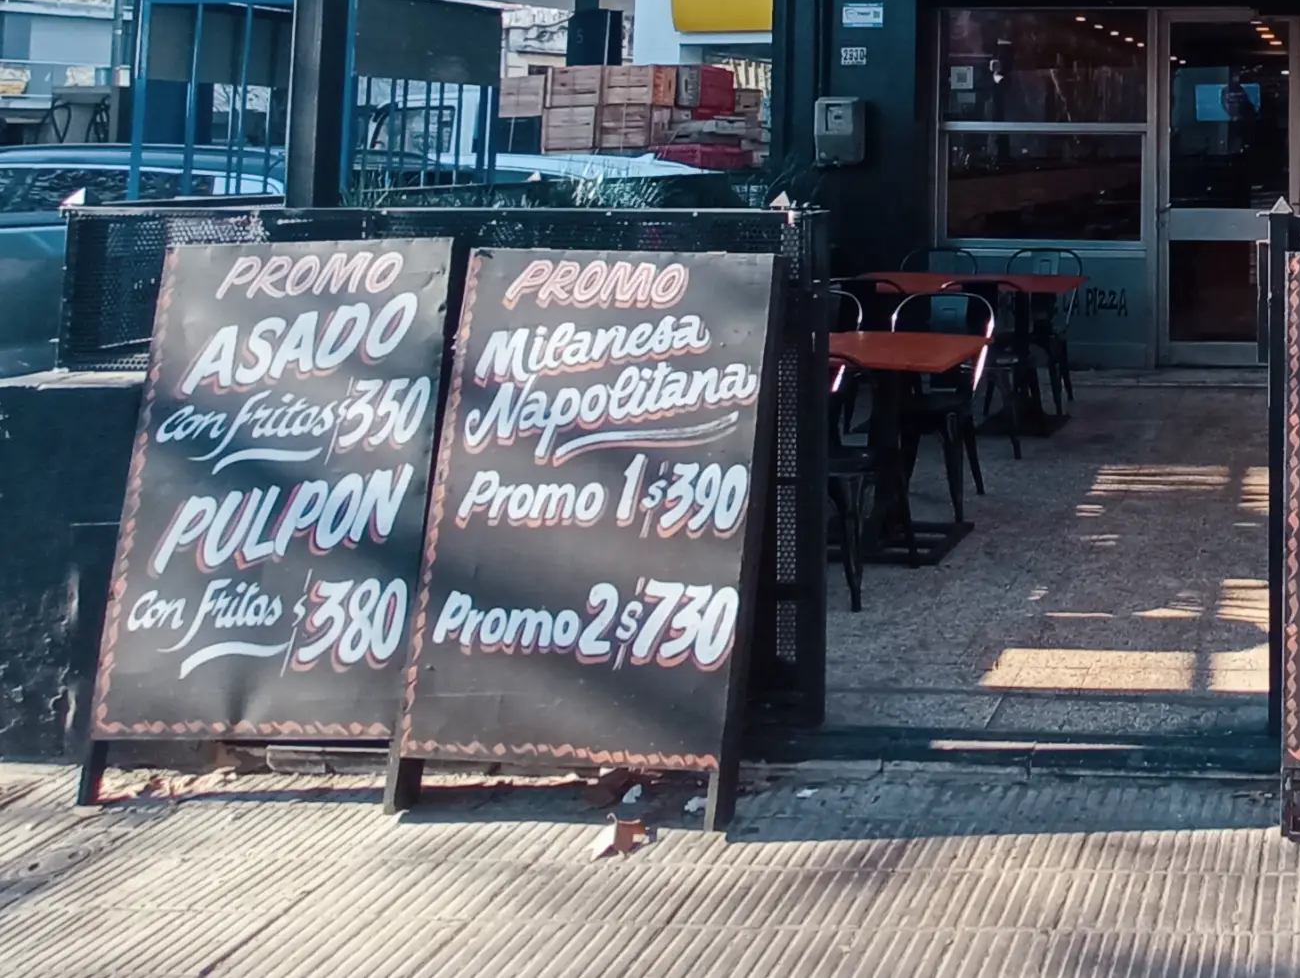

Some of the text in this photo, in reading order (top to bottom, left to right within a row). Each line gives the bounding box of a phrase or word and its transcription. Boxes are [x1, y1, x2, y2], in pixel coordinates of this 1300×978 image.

[216, 251, 404, 299] PROMO
[503, 260, 689, 309] PROMO
[1085, 287, 1128, 317] PIZZA
[177, 292, 418, 399] ASADO
[475, 314, 711, 387] Milanesa
[463, 362, 758, 465] Napolitana
[150, 463, 414, 578] PULPON
[456, 470, 606, 528] Promo
[616, 453, 648, 526] 1
[432, 590, 580, 654] Promo
[576, 582, 619, 664] 2
